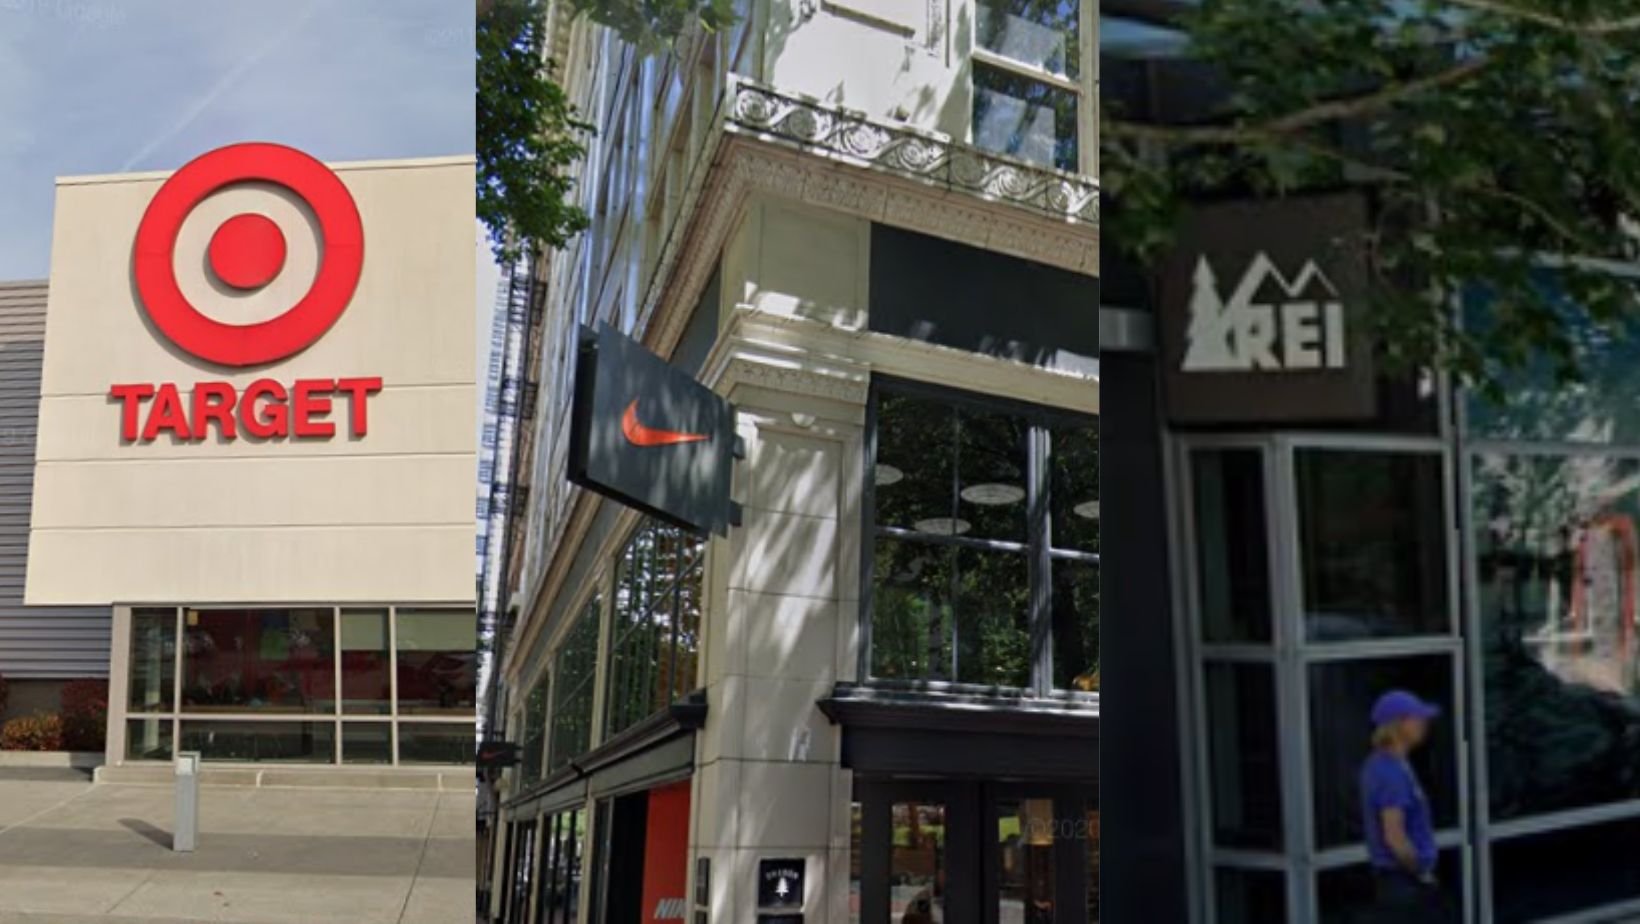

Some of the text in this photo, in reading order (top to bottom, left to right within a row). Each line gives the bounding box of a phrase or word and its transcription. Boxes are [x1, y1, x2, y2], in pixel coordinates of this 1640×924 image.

[1230, 301, 1345, 371] REI
[111, 377, 383, 442] TARGET
[654, 898, 687, 919] NIK
